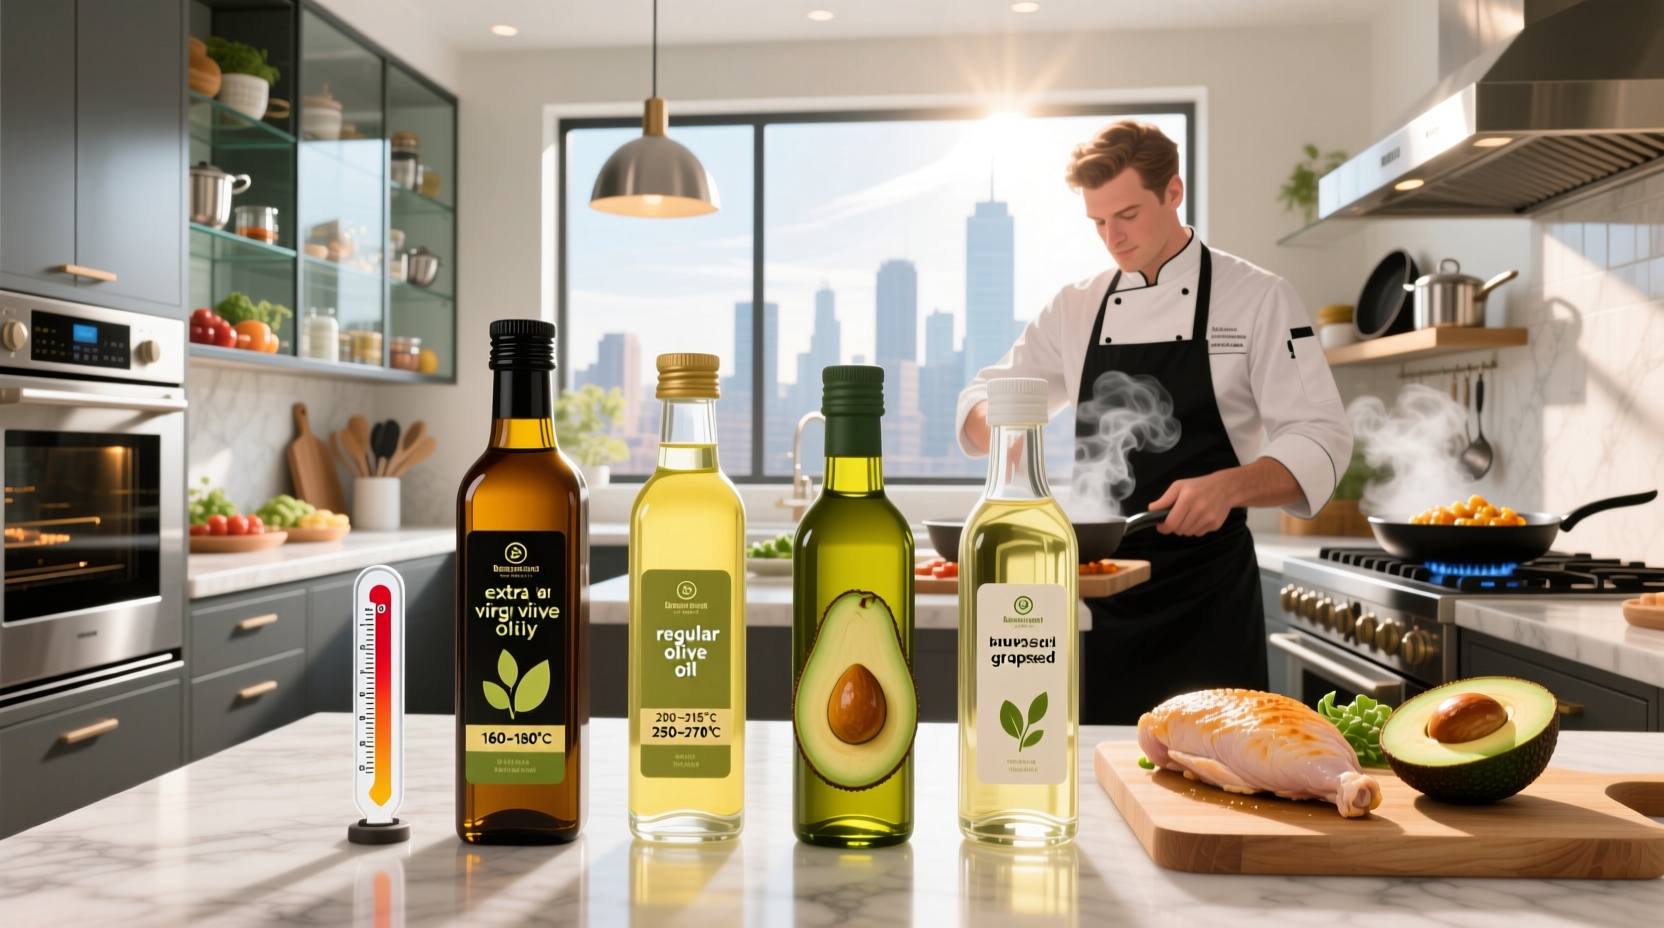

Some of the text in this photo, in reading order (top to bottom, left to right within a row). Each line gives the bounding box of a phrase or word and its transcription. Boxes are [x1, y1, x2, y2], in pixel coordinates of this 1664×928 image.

[485, 584, 529, 600] extra
[656, 624, 720, 646] regular
[664, 644, 708, 660] olive
[675, 661, 697, 677] oil
